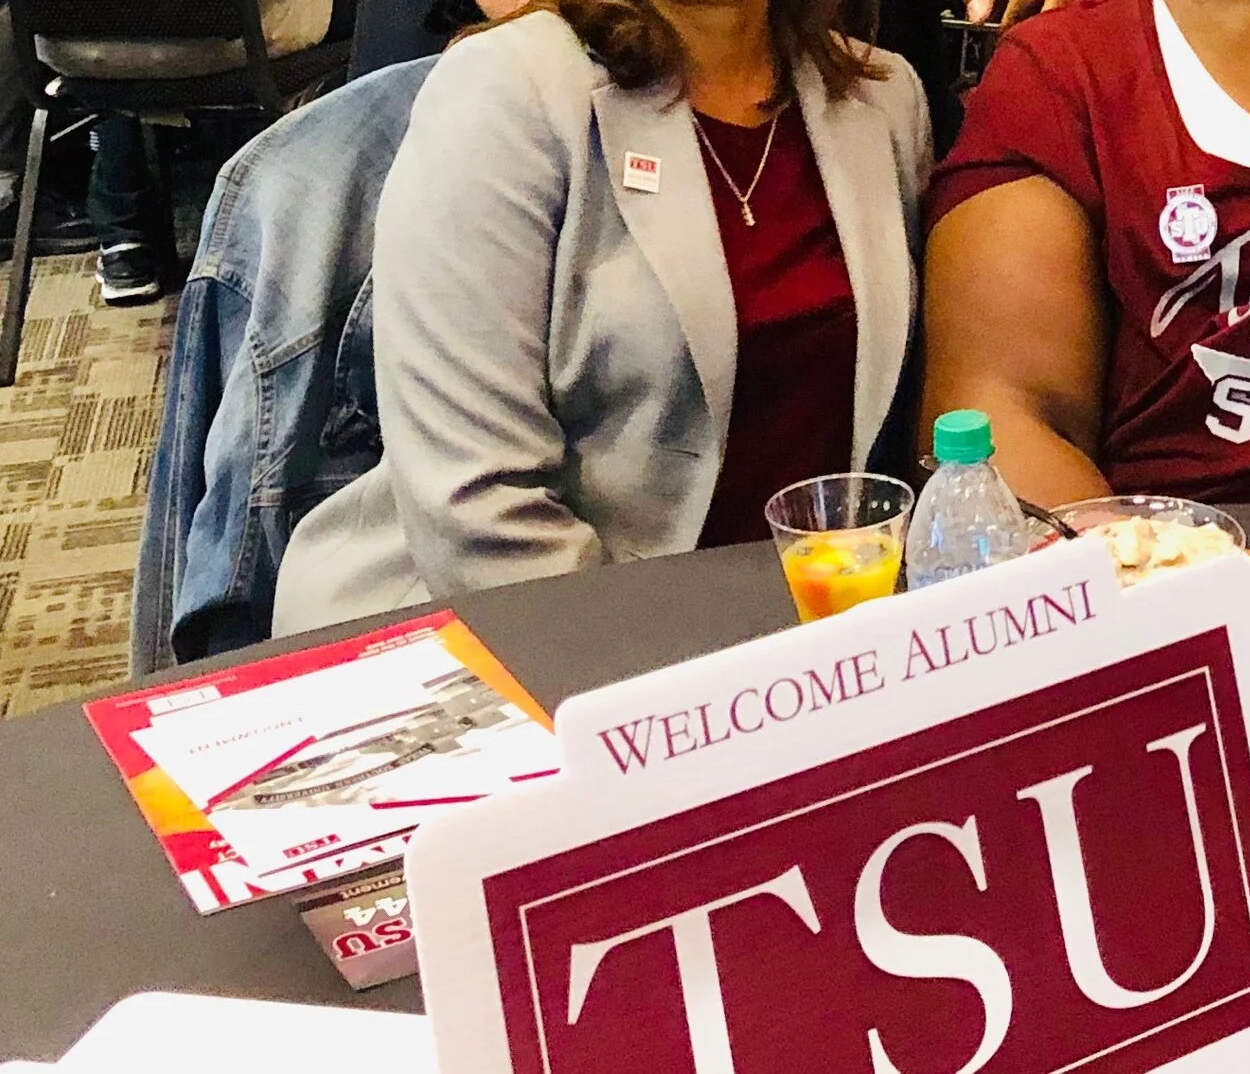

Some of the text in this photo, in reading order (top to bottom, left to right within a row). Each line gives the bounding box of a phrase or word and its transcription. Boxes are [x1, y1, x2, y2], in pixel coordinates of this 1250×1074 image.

[596, 580, 1098, 776] WELCOME ALUMNI
[332, 916, 414, 961] SU
[343, 896, 409, 927] 44
[567, 722, 1216, 1074] TSU
